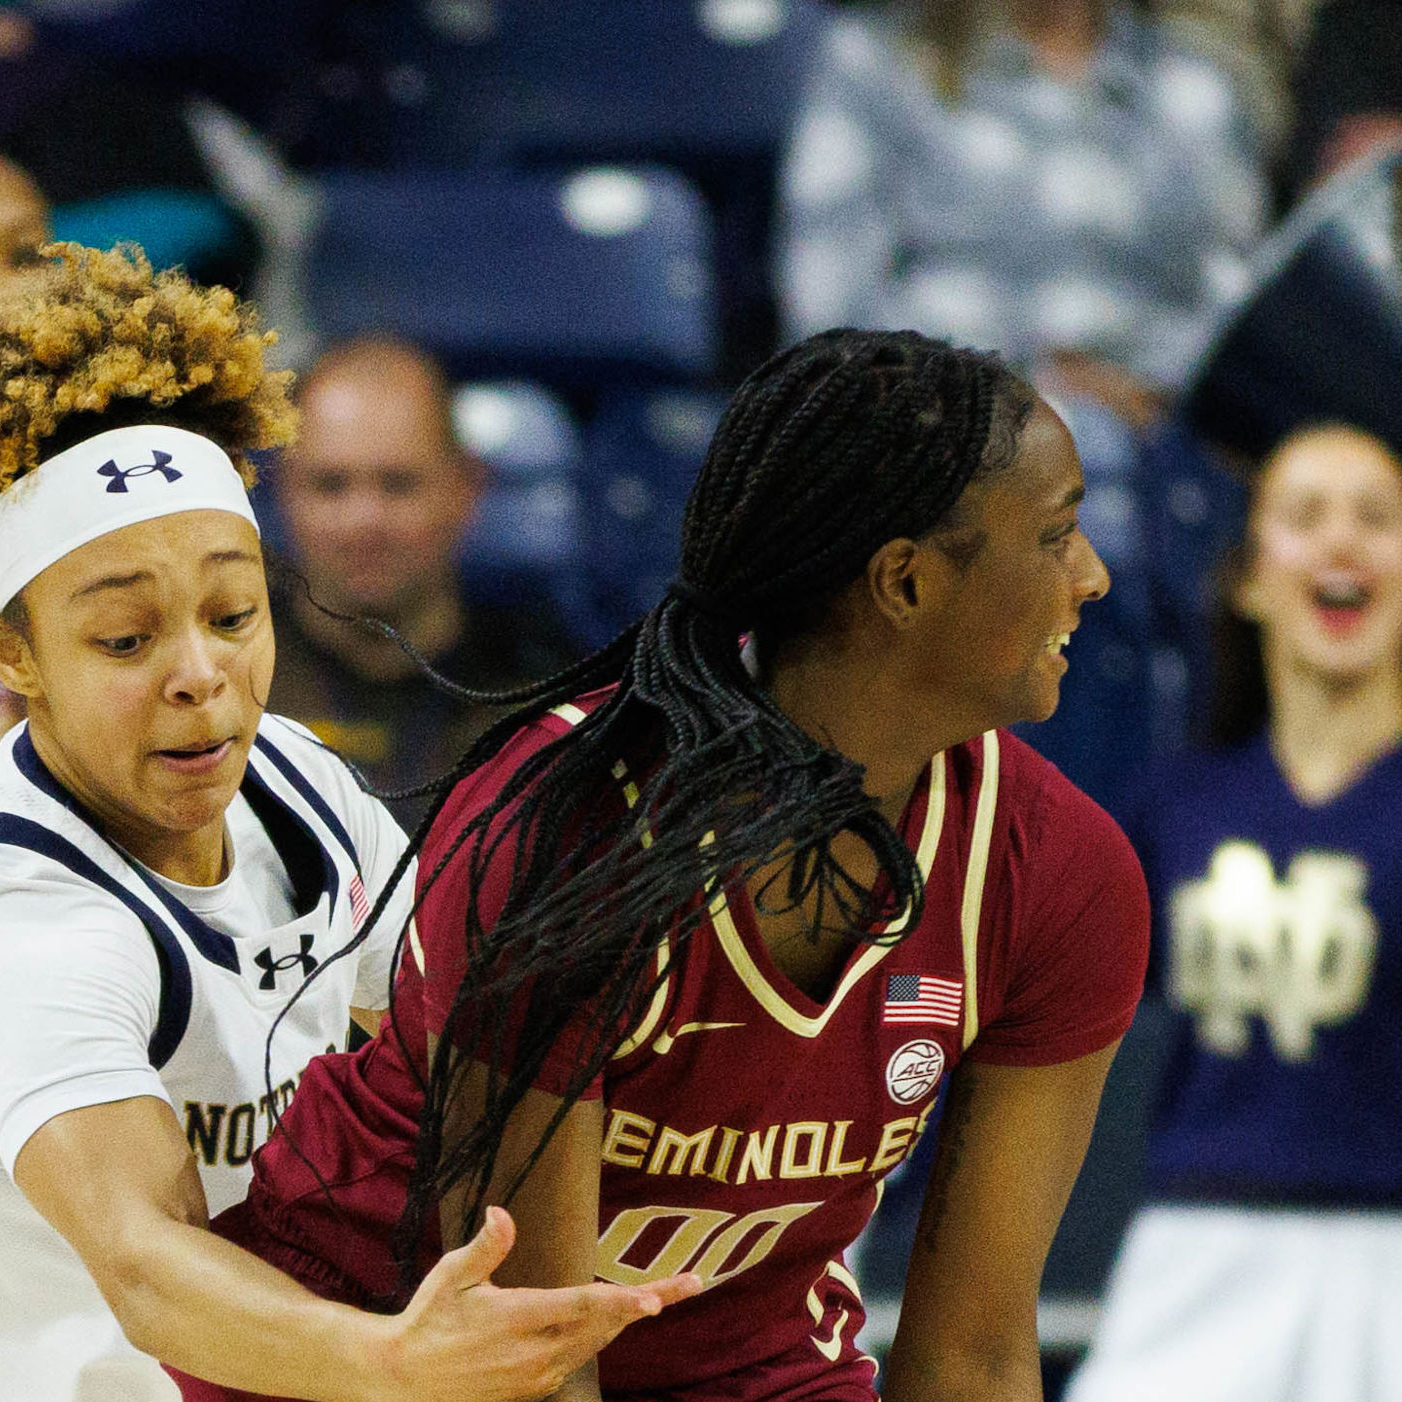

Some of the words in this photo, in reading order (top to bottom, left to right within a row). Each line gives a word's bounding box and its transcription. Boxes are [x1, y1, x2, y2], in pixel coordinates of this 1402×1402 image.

[897, 1058, 941, 1078] ACC
[599, 1098, 938, 1186] EMINOLE
[595, 1200, 827, 1290] 00
